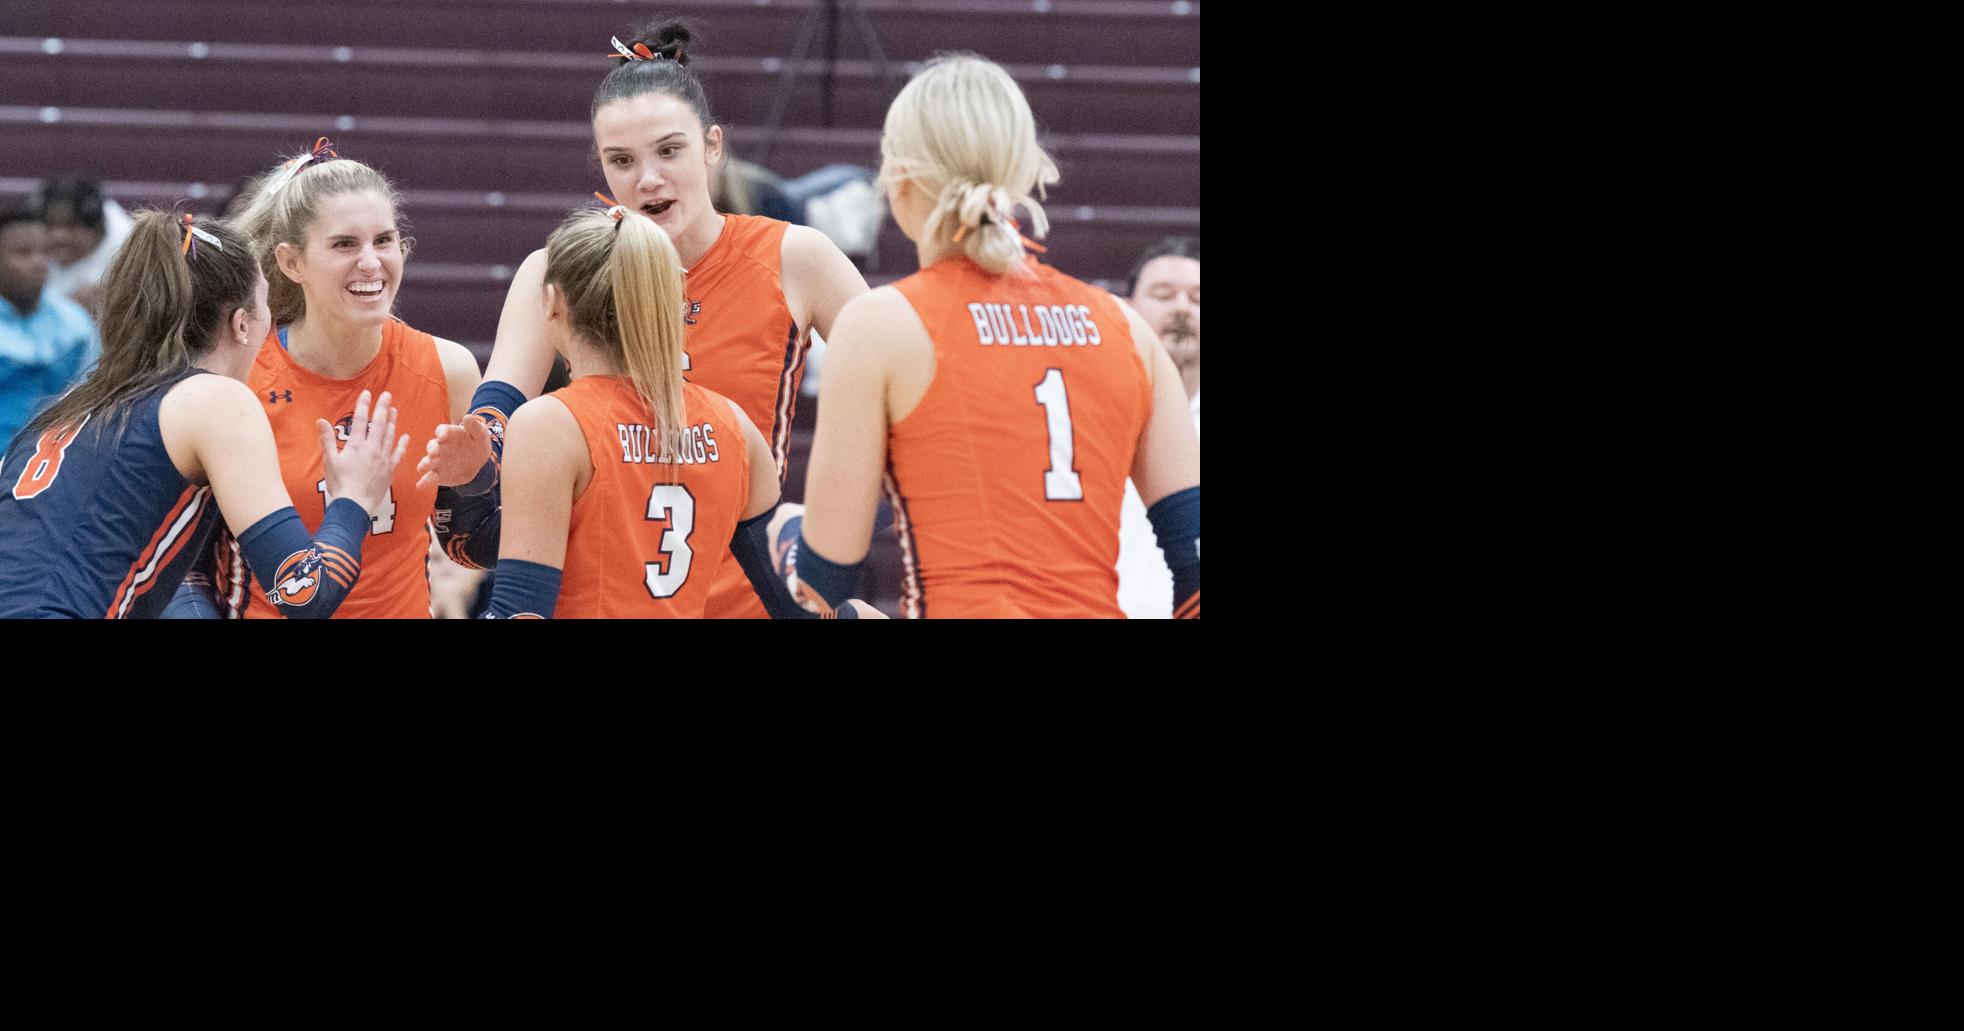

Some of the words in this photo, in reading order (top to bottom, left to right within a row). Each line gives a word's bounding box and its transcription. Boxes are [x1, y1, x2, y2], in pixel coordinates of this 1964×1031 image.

[967, 302, 1101, 346] BULLDOGS
[12, 413, 91, 500] 8
[617, 423, 719, 464] BULOGS
[1033, 367, 1083, 501] 1
[643, 483, 695, 598] 3
